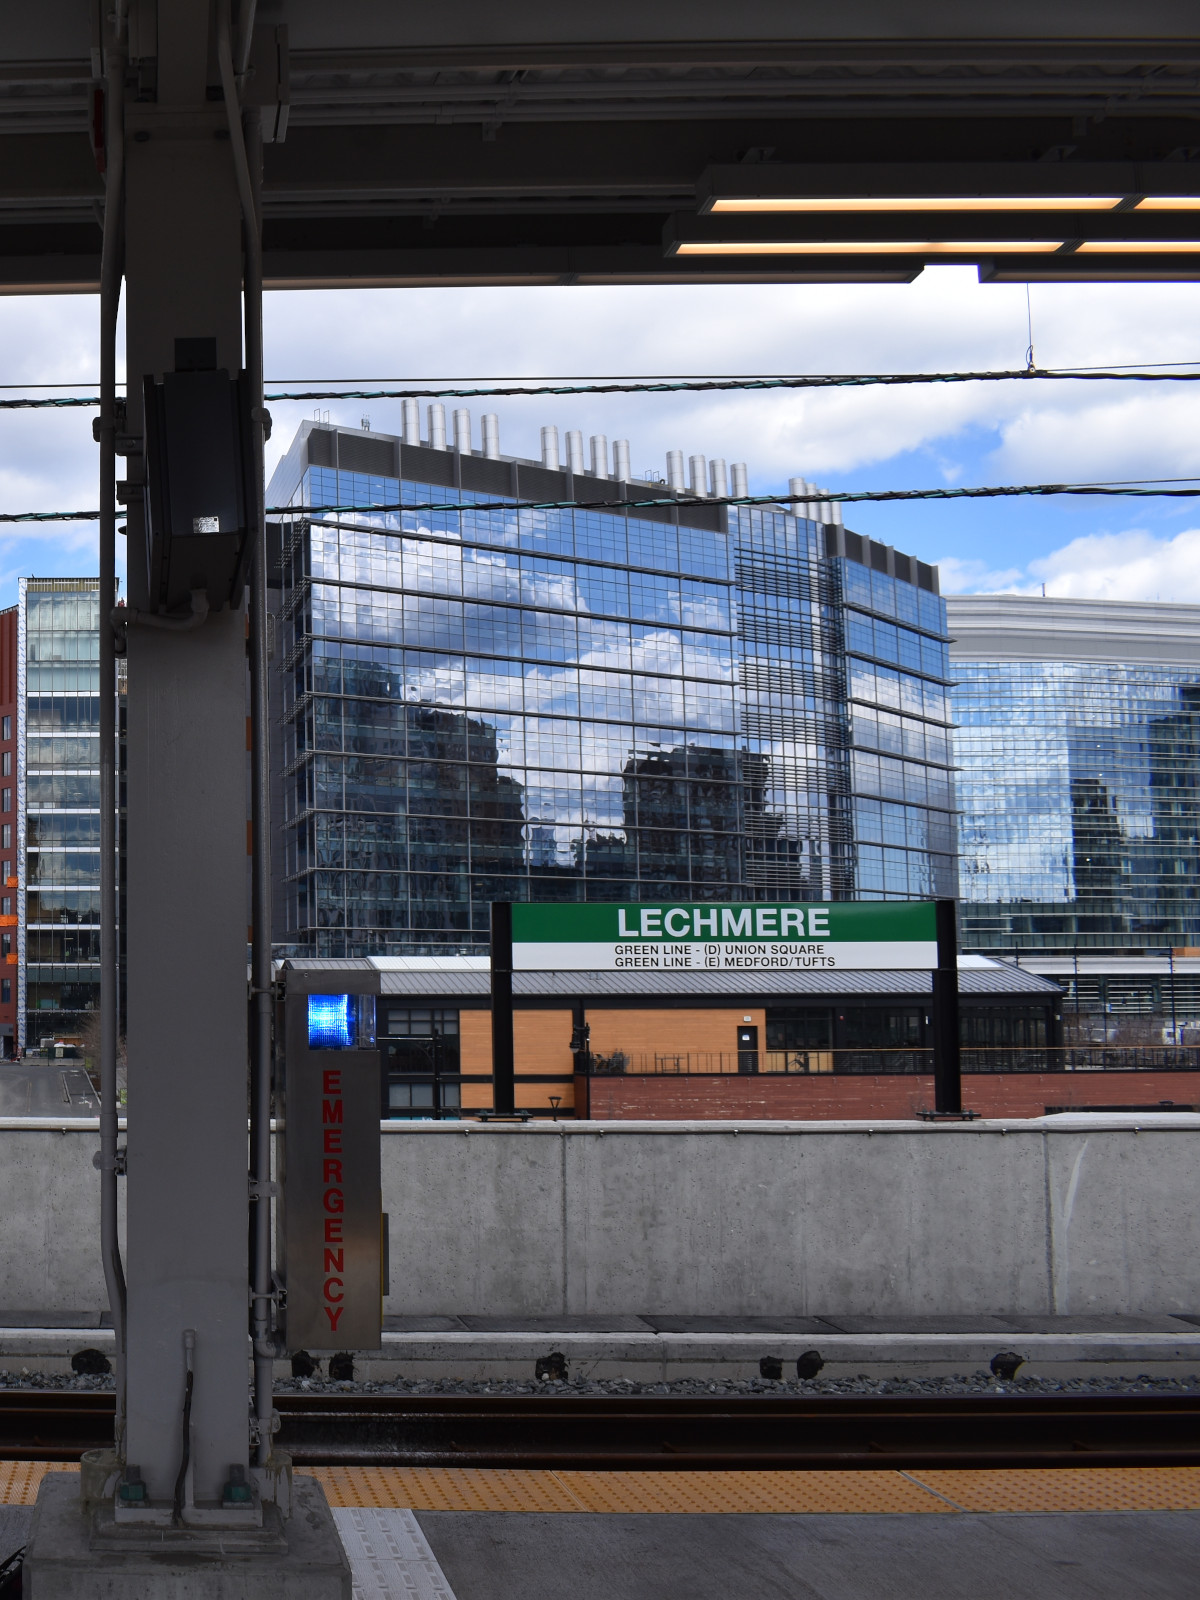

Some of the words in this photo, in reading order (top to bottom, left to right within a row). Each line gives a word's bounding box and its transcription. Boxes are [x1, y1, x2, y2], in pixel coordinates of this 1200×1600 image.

[618, 907, 831, 937] LECHMERE
[614, 945, 659, 955] GREEN
[663, 945, 692, 955] LINE
[704, 944, 721, 957] (D)
[725, 945, 767, 955] UNION
[770, 944, 825, 956] SQUARE
[614, 957, 659, 967] GREEN
[663, 957, 692, 967] LINE
[704, 956, 721, 969] (E)
[724, 956, 836, 968] MEDFORD/TUFTS
[321, 1069, 345, 1332] EMERGENCY
